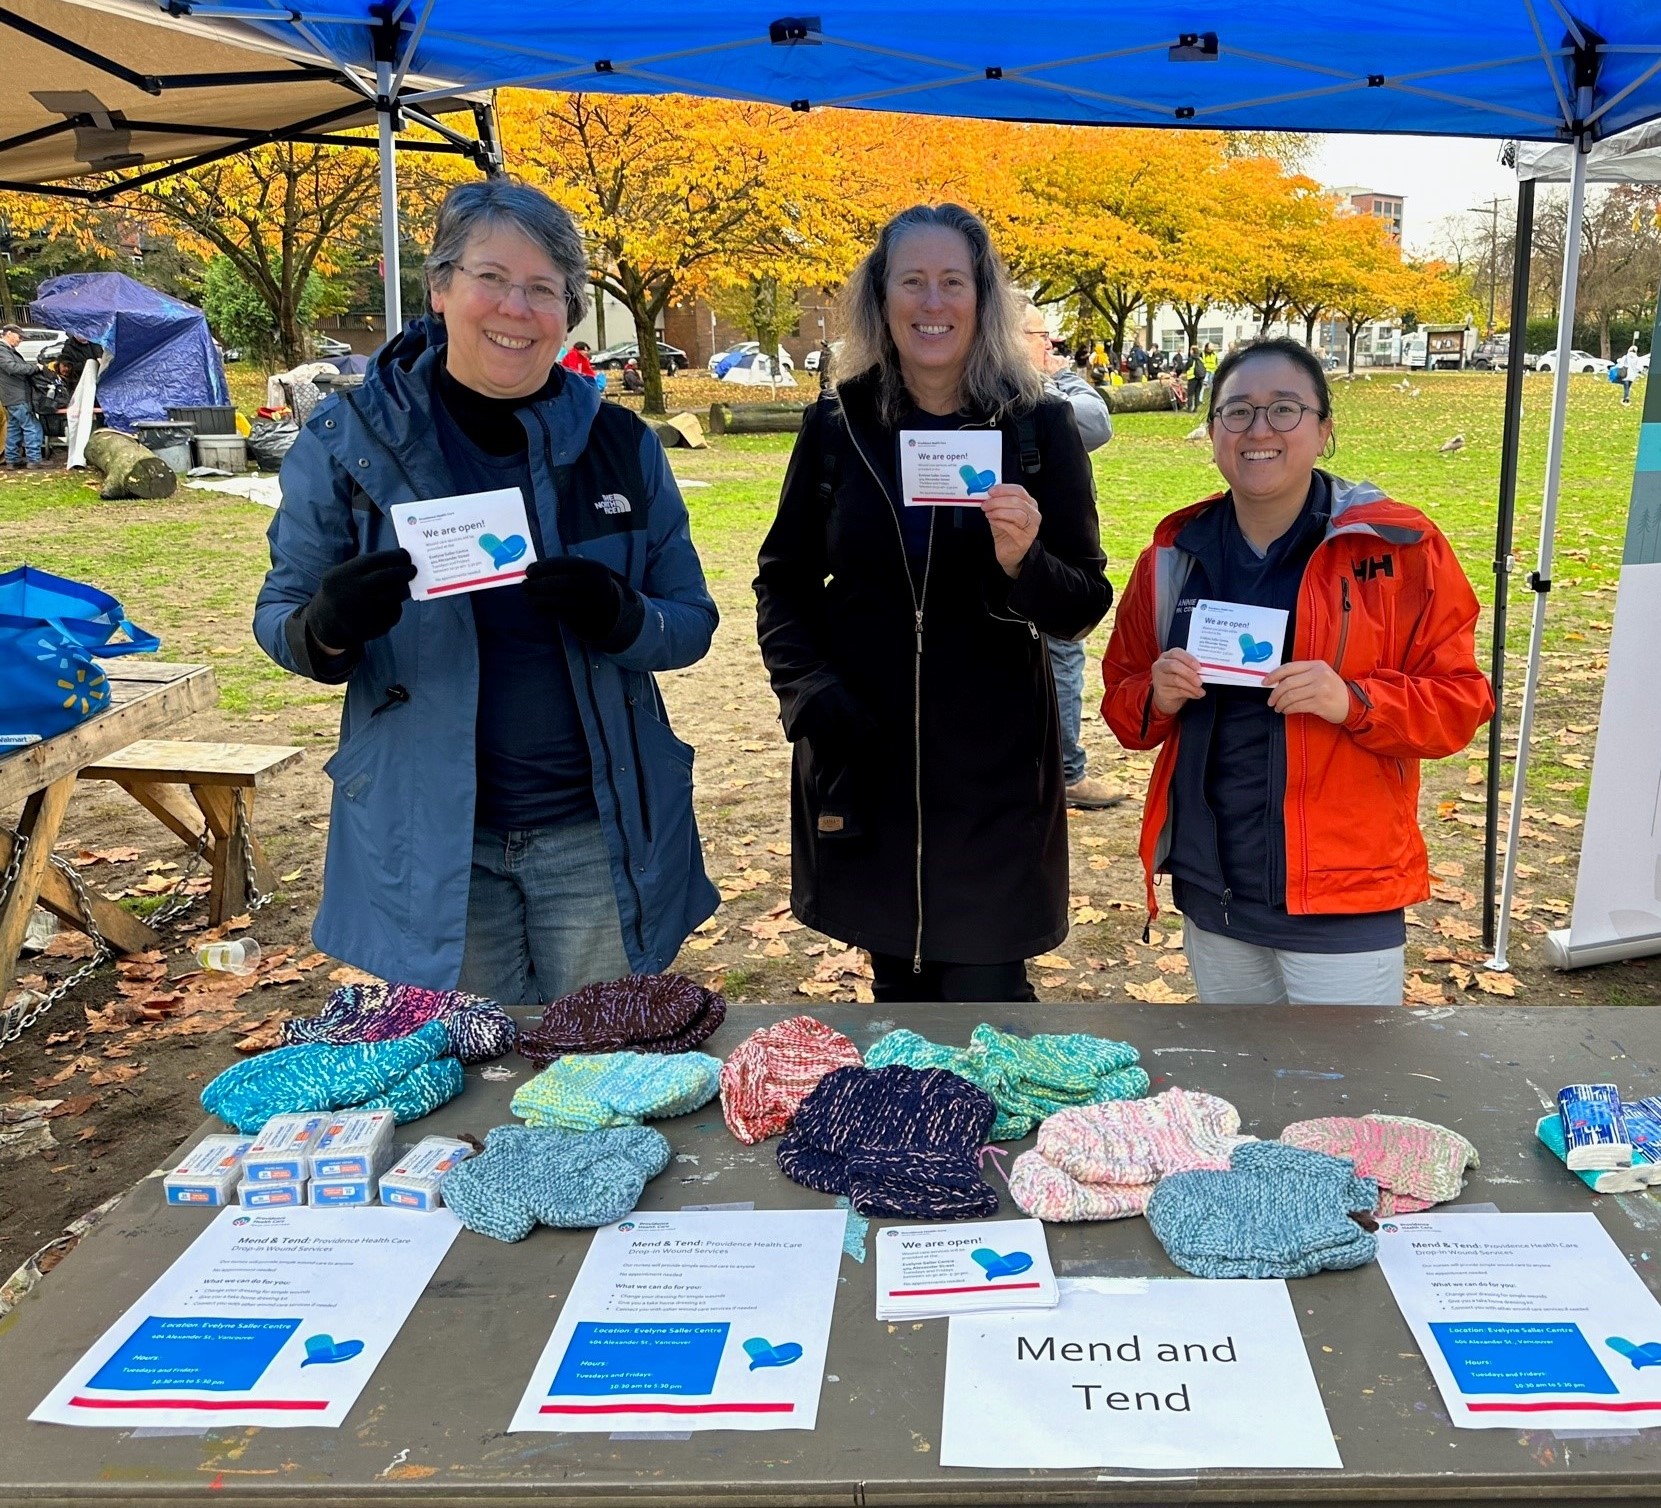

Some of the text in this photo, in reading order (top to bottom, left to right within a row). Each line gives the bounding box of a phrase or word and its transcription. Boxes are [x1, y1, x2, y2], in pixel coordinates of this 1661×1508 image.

[946, 453, 968, 461] open!
[422, 520, 486, 539] We are open!
[1205, 617, 1216, 625] We
[631, 1240, 662, 1248] Mend
[902, 1241, 922, 1249] We
[947, 1237, 982, 1247] open!
[1018, 1335, 1237, 1362] Mend and
[1072, 1383, 1191, 1411] Tend
